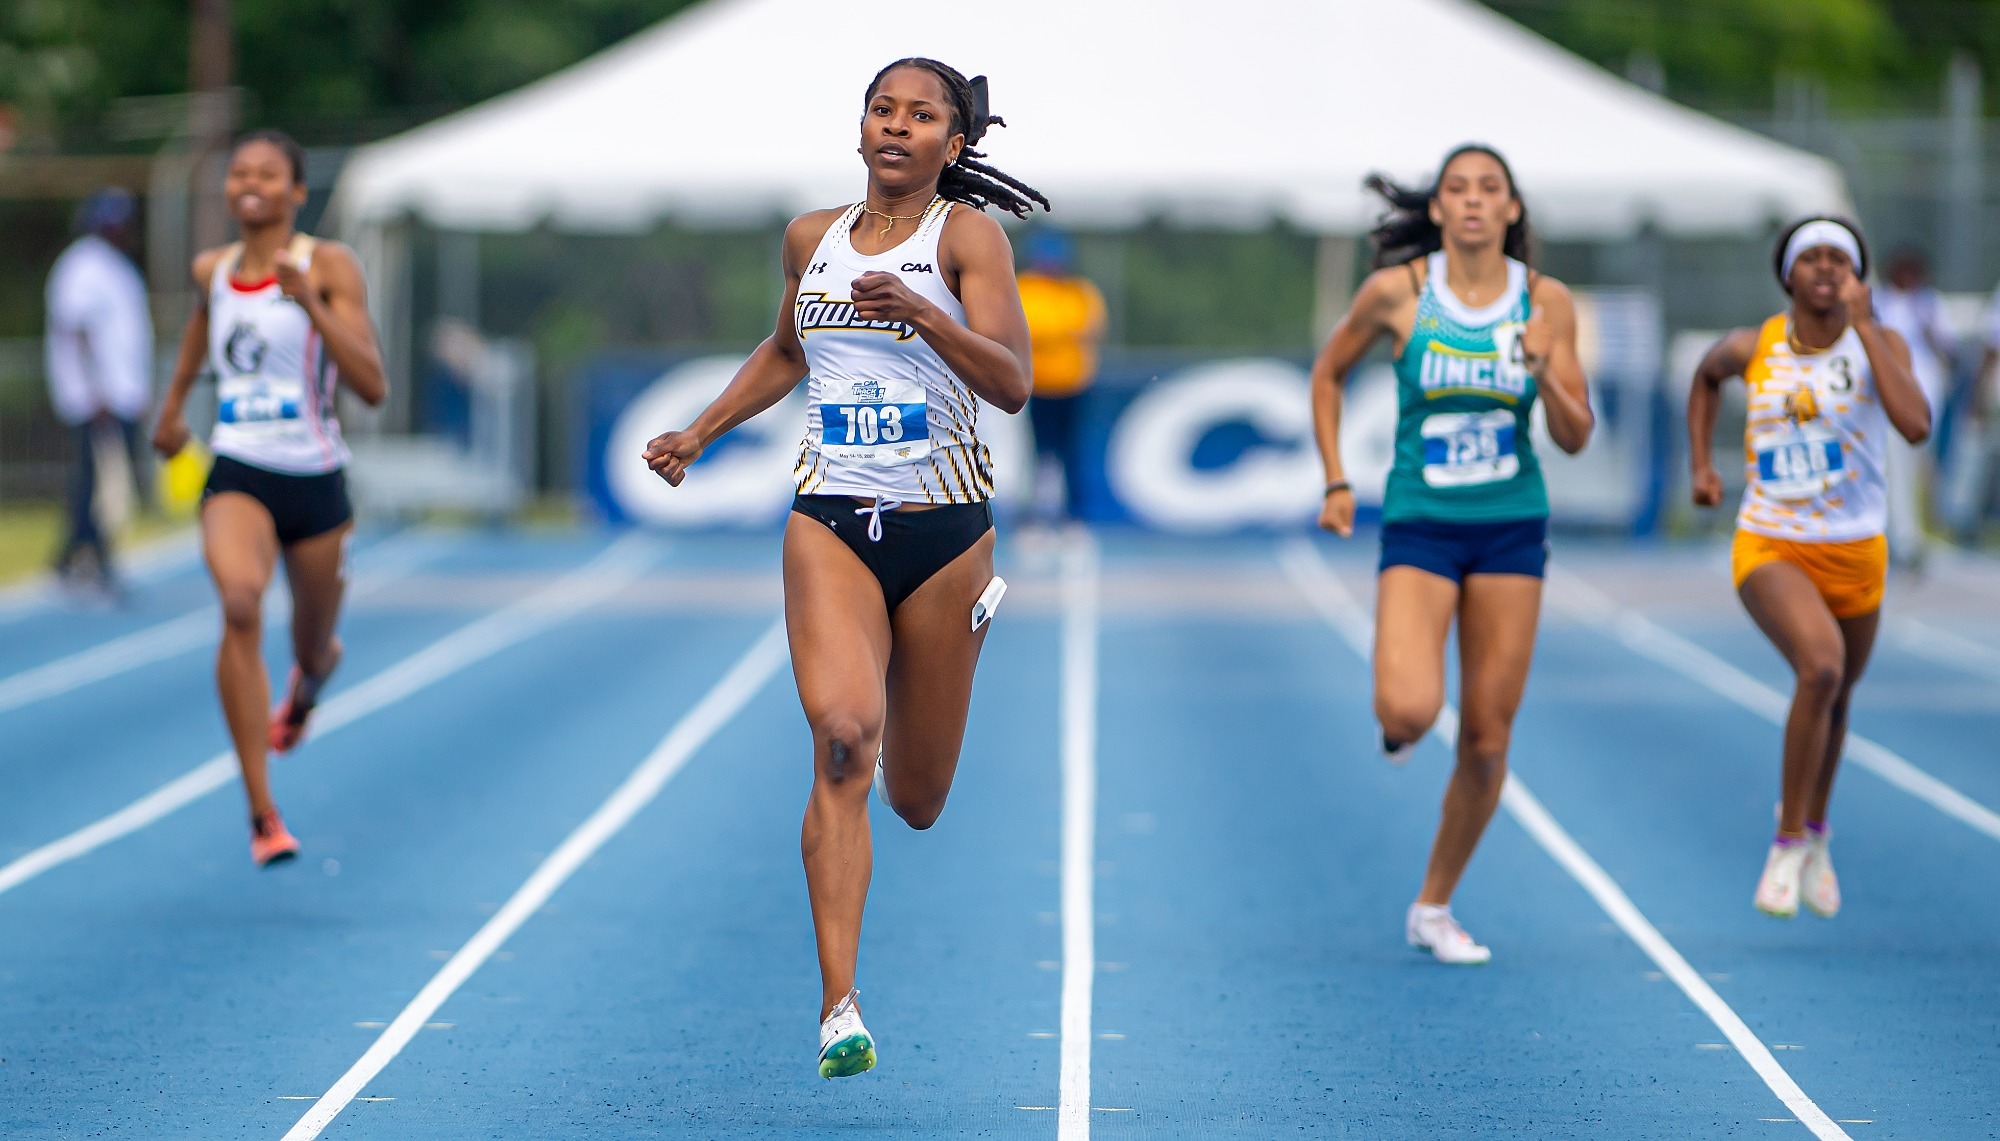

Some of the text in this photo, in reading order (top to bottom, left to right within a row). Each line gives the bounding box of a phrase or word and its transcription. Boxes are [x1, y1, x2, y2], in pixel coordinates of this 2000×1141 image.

[900, 262, 933, 274] CAA
[1829, 355, 1853, 393] 3
[840, 405, 904, 444] 703
